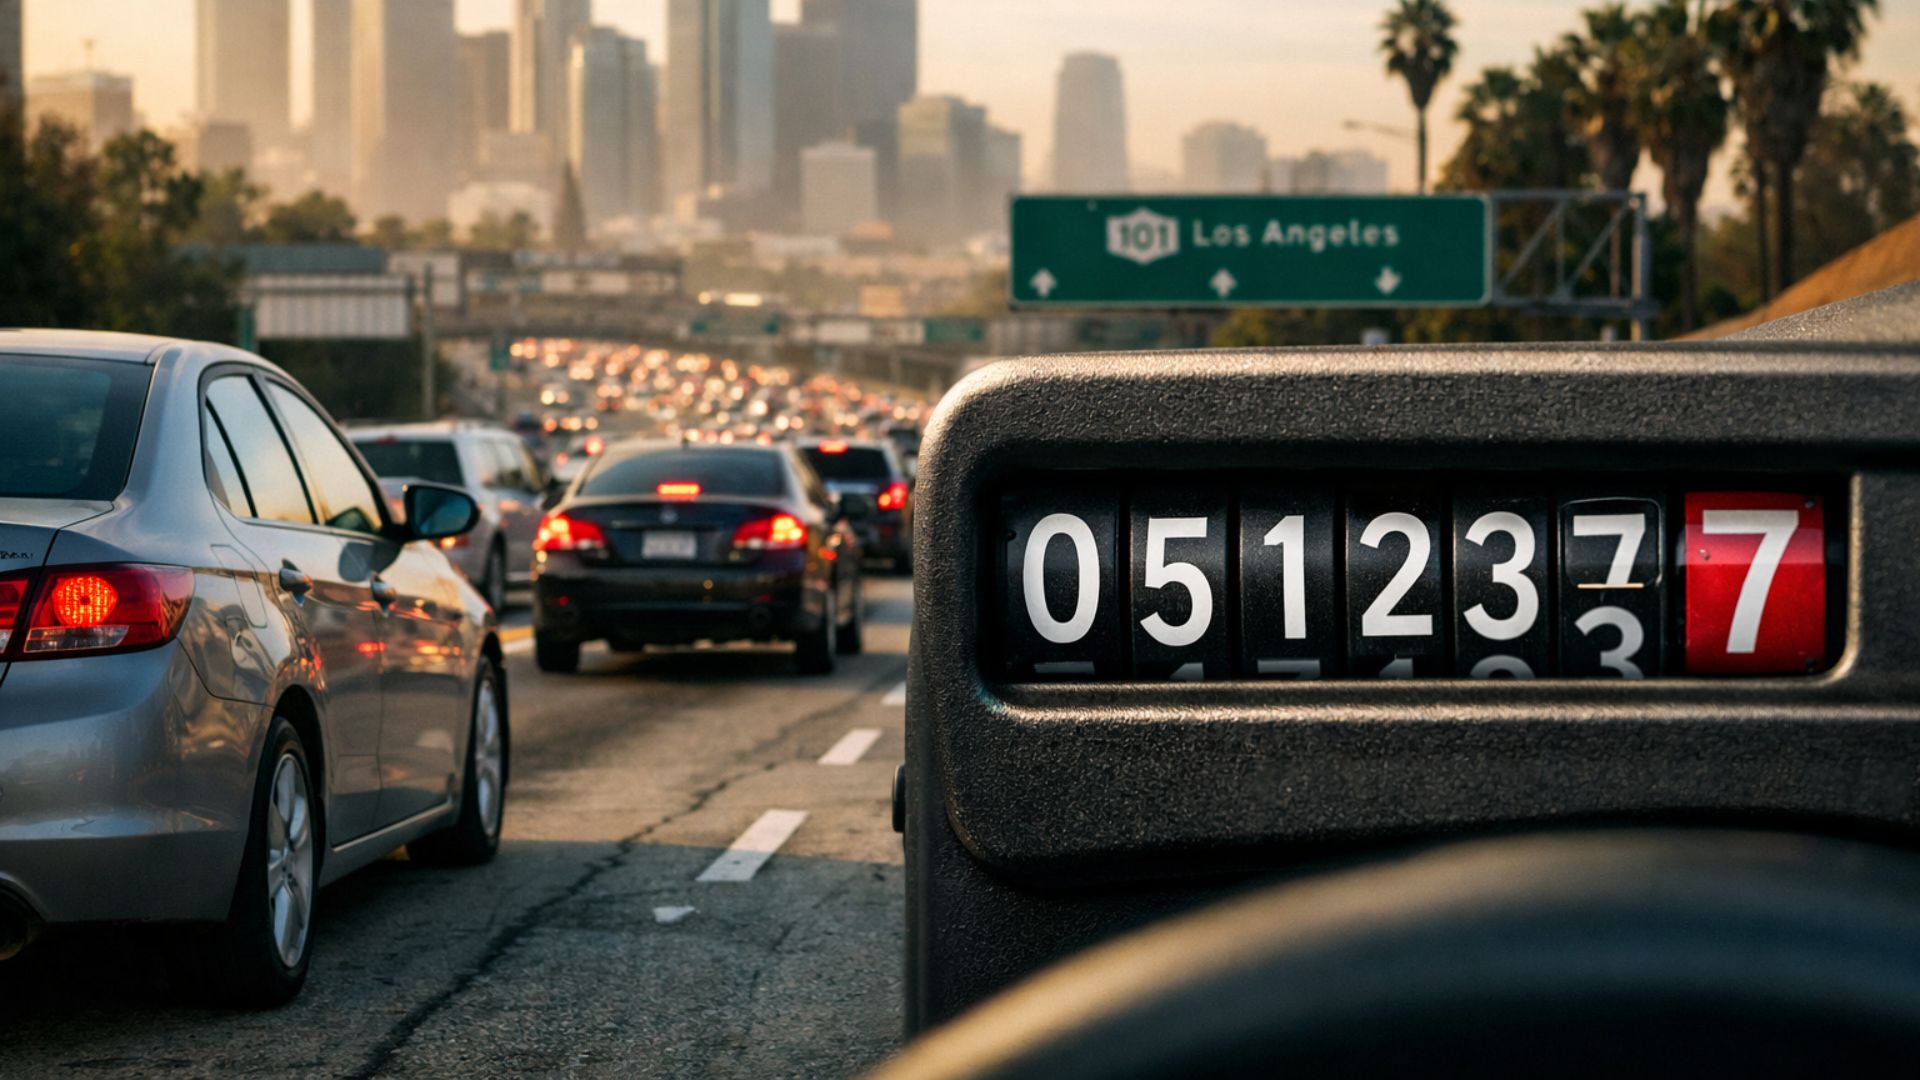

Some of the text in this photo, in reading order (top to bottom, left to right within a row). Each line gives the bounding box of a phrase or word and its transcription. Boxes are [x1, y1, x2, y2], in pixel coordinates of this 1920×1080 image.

[1119, 219, 1398, 252] 101 Los Angeles
